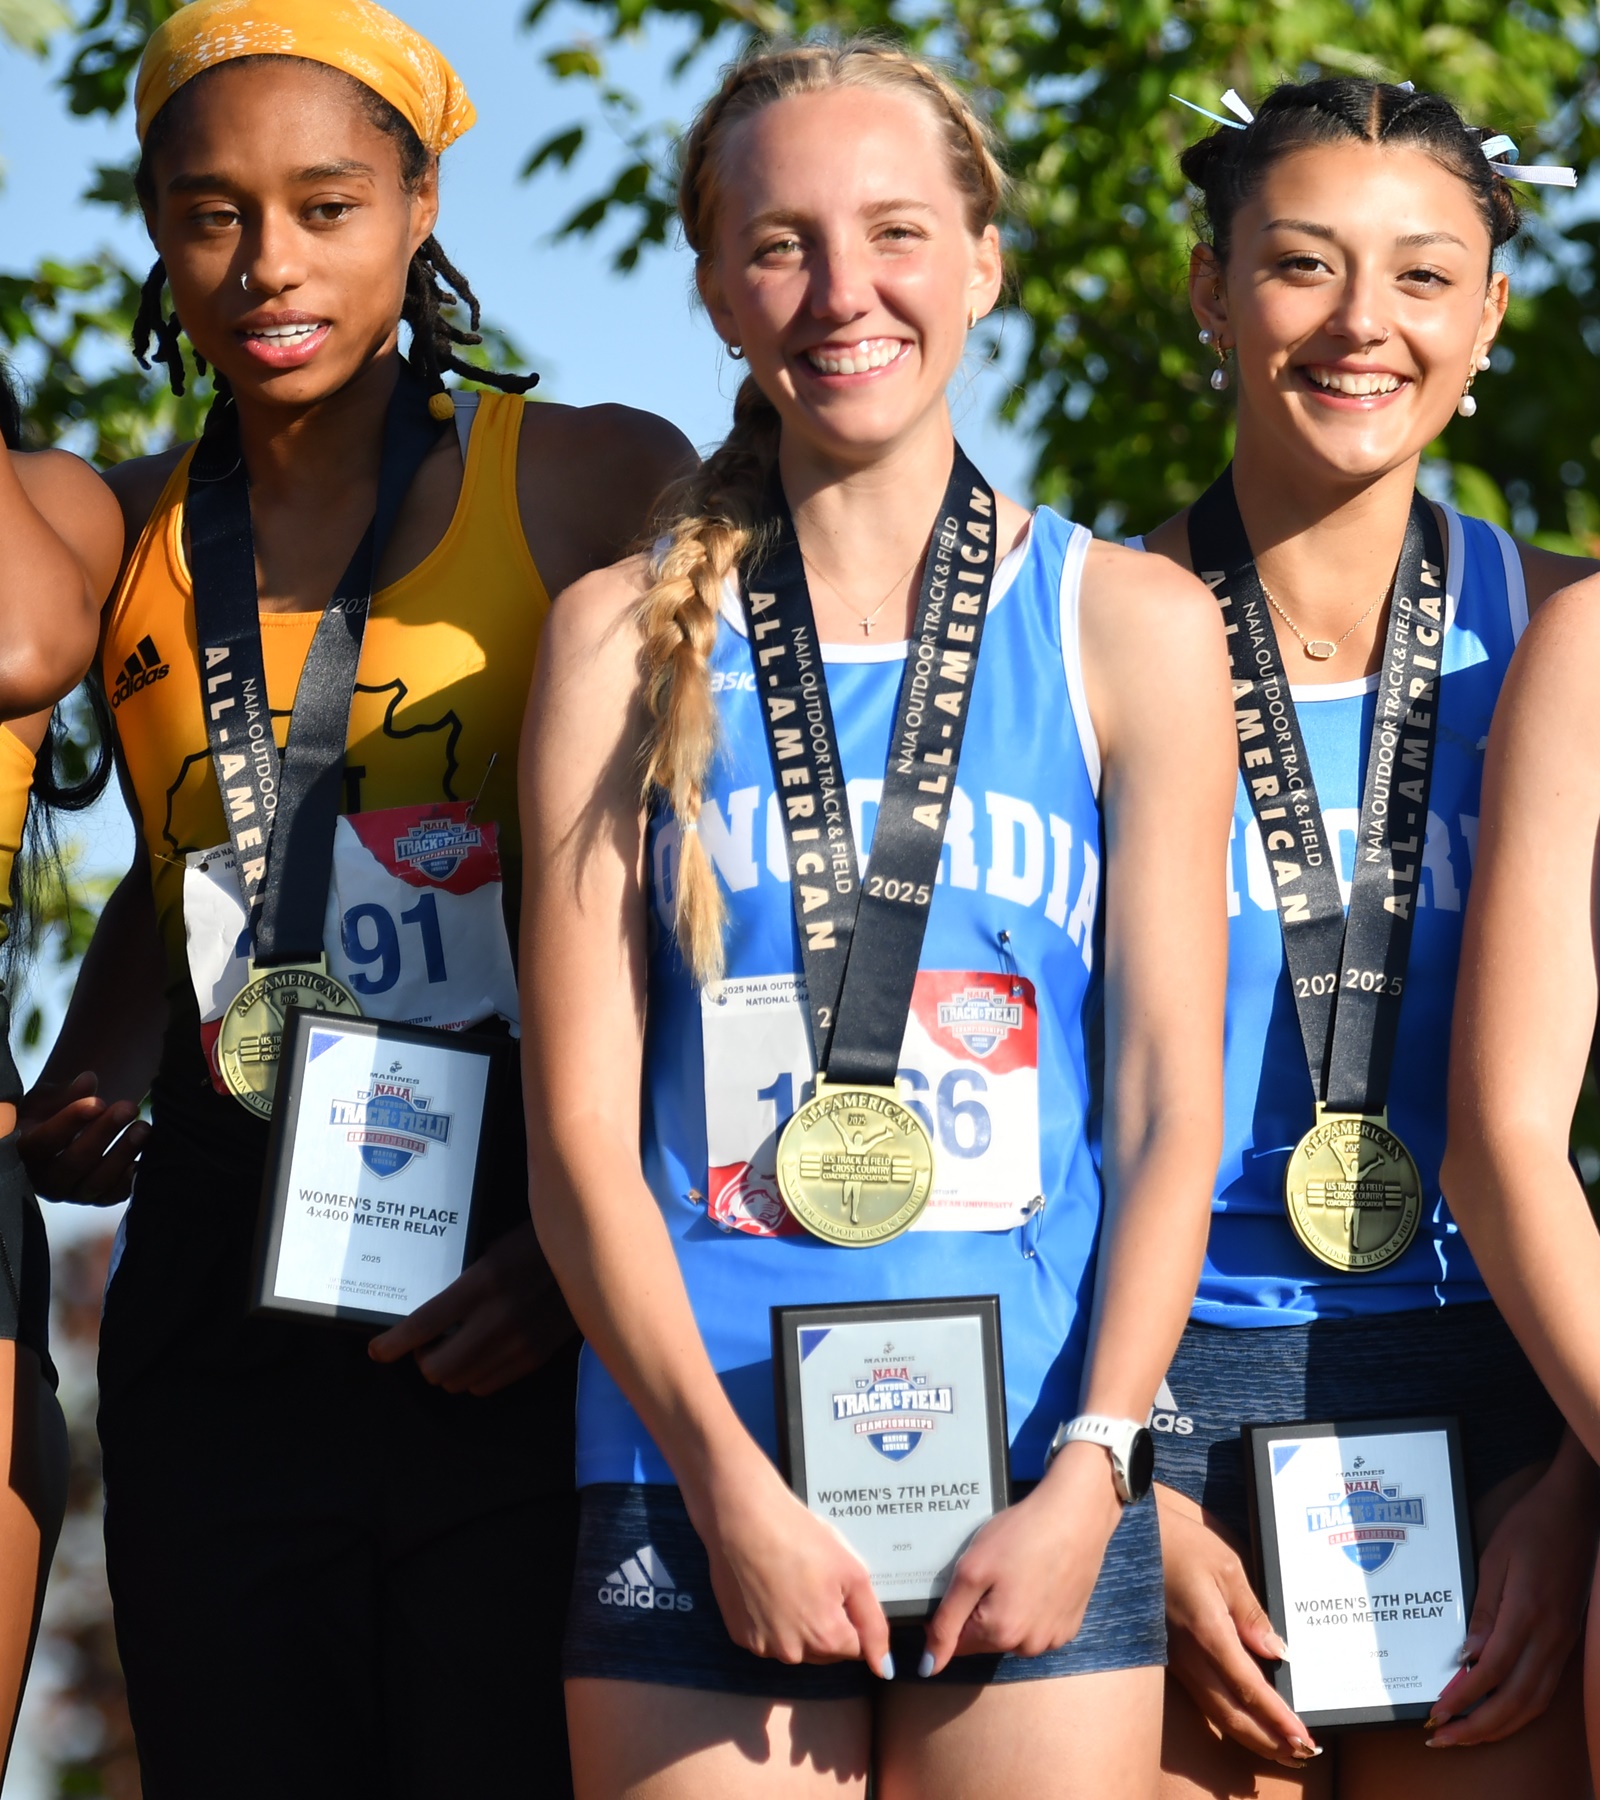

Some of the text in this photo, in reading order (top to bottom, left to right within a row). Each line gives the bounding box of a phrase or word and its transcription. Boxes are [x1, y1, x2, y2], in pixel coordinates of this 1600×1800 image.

[897, 516, 959, 773] NAIA OUTDOOR TRACK & FIELD
[912, 487, 992, 830] ALL-AMERICAN
[111, 664, 170, 709] adidas
[711, 671, 757, 692] asic
[242, 678, 261, 722] NAIA
[1243, 601, 1322, 867] NAIA OUTDOOR TRACK & FIELD
[1366, 596, 1412, 863] NAIA OUTDOOR TRACK & FIELD
[1383, 559, 1441, 920] ALL-AMERICAN
[749, 592, 836, 951] ALL-AMERICAN
[791, 626, 851, 894] NAIA OUTDOOR TRACK & FIELD
[205, 648, 268, 908] ALL-AMERI
[869, 876, 929, 905] 2025
[236, 973, 344, 1018] ALL-AMERICAN
[723, 980, 807, 995] 2025 NAIA OUTDOO
[1296, 973, 1337, 998] 202
[1345, 969, 1403, 995] 2025
[745, 997, 790, 1006] NATIONAL
[374, 1084, 411, 1100] NAIA
[332, 1102, 388, 1126] TRACK
[400, 1112, 449, 1137] FIELD
[800, 1093, 917, 1135] ALL-AMERICAN
[348, 1132, 425, 1152] CHAMPIONSHIPS
[1304, 1122, 1402, 1161] ALL-AMERICAN
[299, 1189, 458, 1224] WOMEN'S 5TH PLACE
[306, 1206, 447, 1237] 4x400 METER RELAY
[361, 1253, 381, 1263] 2025
[872, 1367, 909, 1381] NAIA
[834, 1392, 892, 1418] TRACK
[901, 1389, 951, 1413] FIELD
[855, 1420, 932, 1433] CHAMPIONSHIPS
[817, 1483, 980, 1503] WOMEN'S 7TH PLACE
[1345, 1481, 1379, 1495] NAIA
[829, 1500, 970, 1518] 4x400 METER RELAY
[598, 1584, 693, 1611] adidas
[1295, 1590, 1452, 1613] WOMEN'S 7TH PLACE
[1306, 1607, 1444, 1626] 4x400 METER RELAY
[1369, 1650, 1388, 1658] 2025
